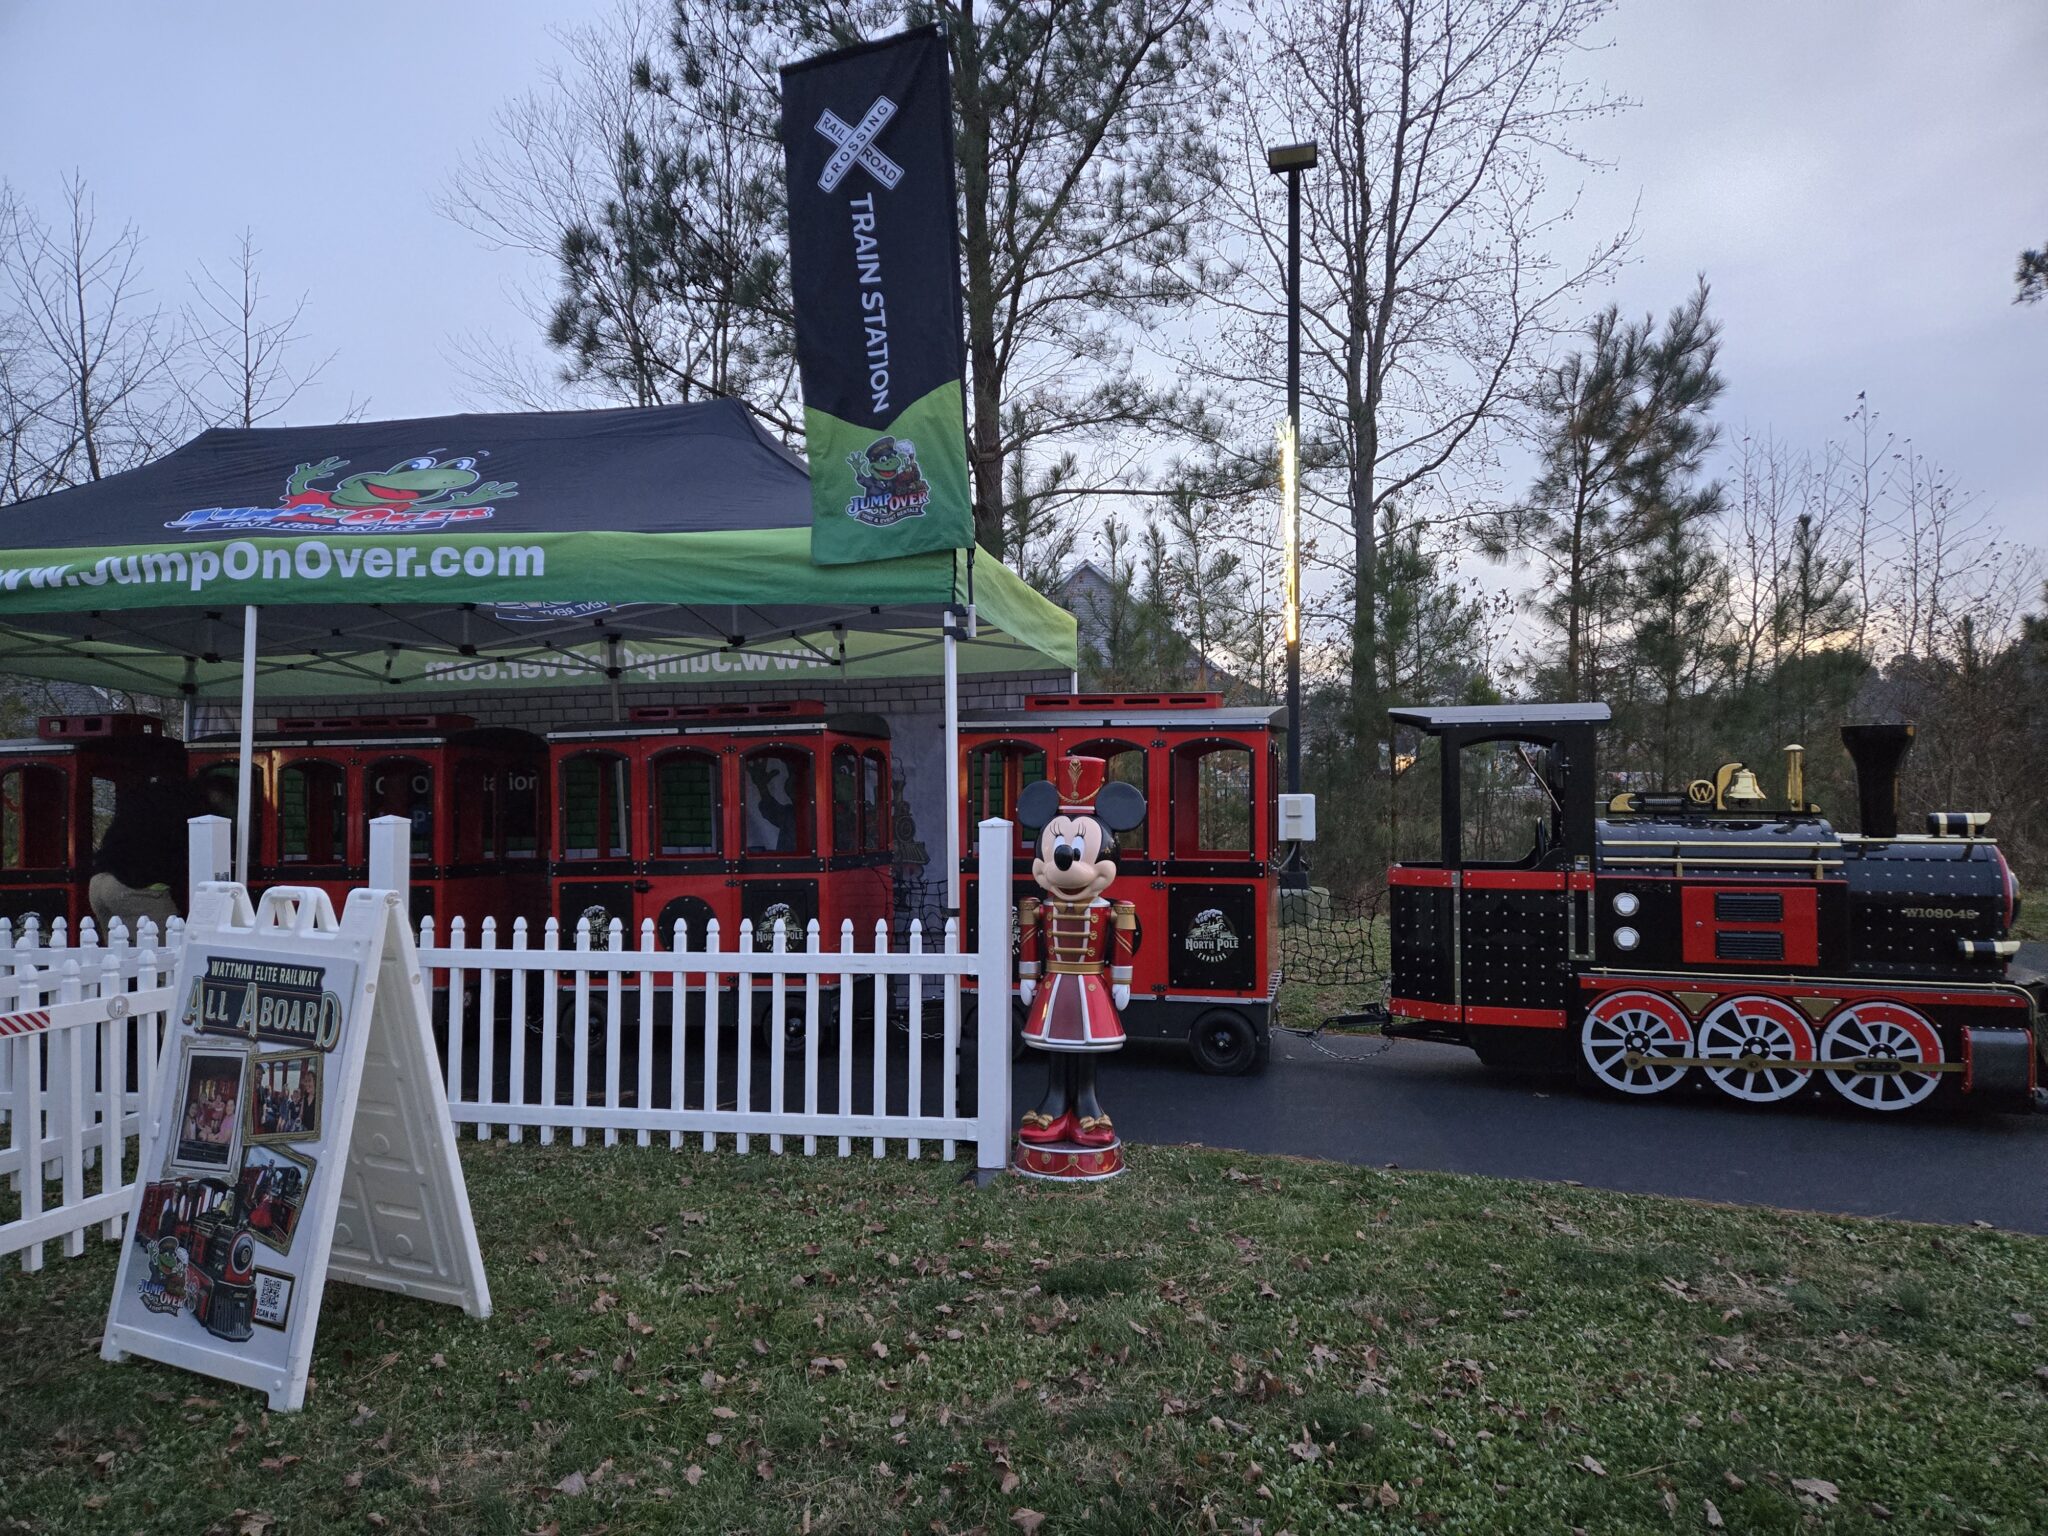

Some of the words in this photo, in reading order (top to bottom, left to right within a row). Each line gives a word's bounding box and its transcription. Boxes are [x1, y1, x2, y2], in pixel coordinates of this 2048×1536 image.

[821, 116, 845, 141] RAIL
[861, 147, 897, 181] ROAD
[824, 105, 888, 183] CROSSING
[850, 192, 882, 284] TRAIN
[861, 291, 890, 414] STATION
[164, 504, 327, 528] JUMP
[339, 507, 495, 525] OVER
[847, 492, 893, 514] JUMP
[889, 491, 929, 511] OVER
[1185, 938, 1214, 951] NORTH
[1217, 938, 1239, 951] POLE
[211, 960, 252, 979] WATTMAN
[254, 965, 278, 983] ELITE
[279, 968, 319, 987] RAILWAY
[182, 975, 229, 1033] ALL
[236, 982, 342, 1052] ABOARD
[255, 1307, 270, 1318] SCAN
[269, 1311, 279, 1320] ME
